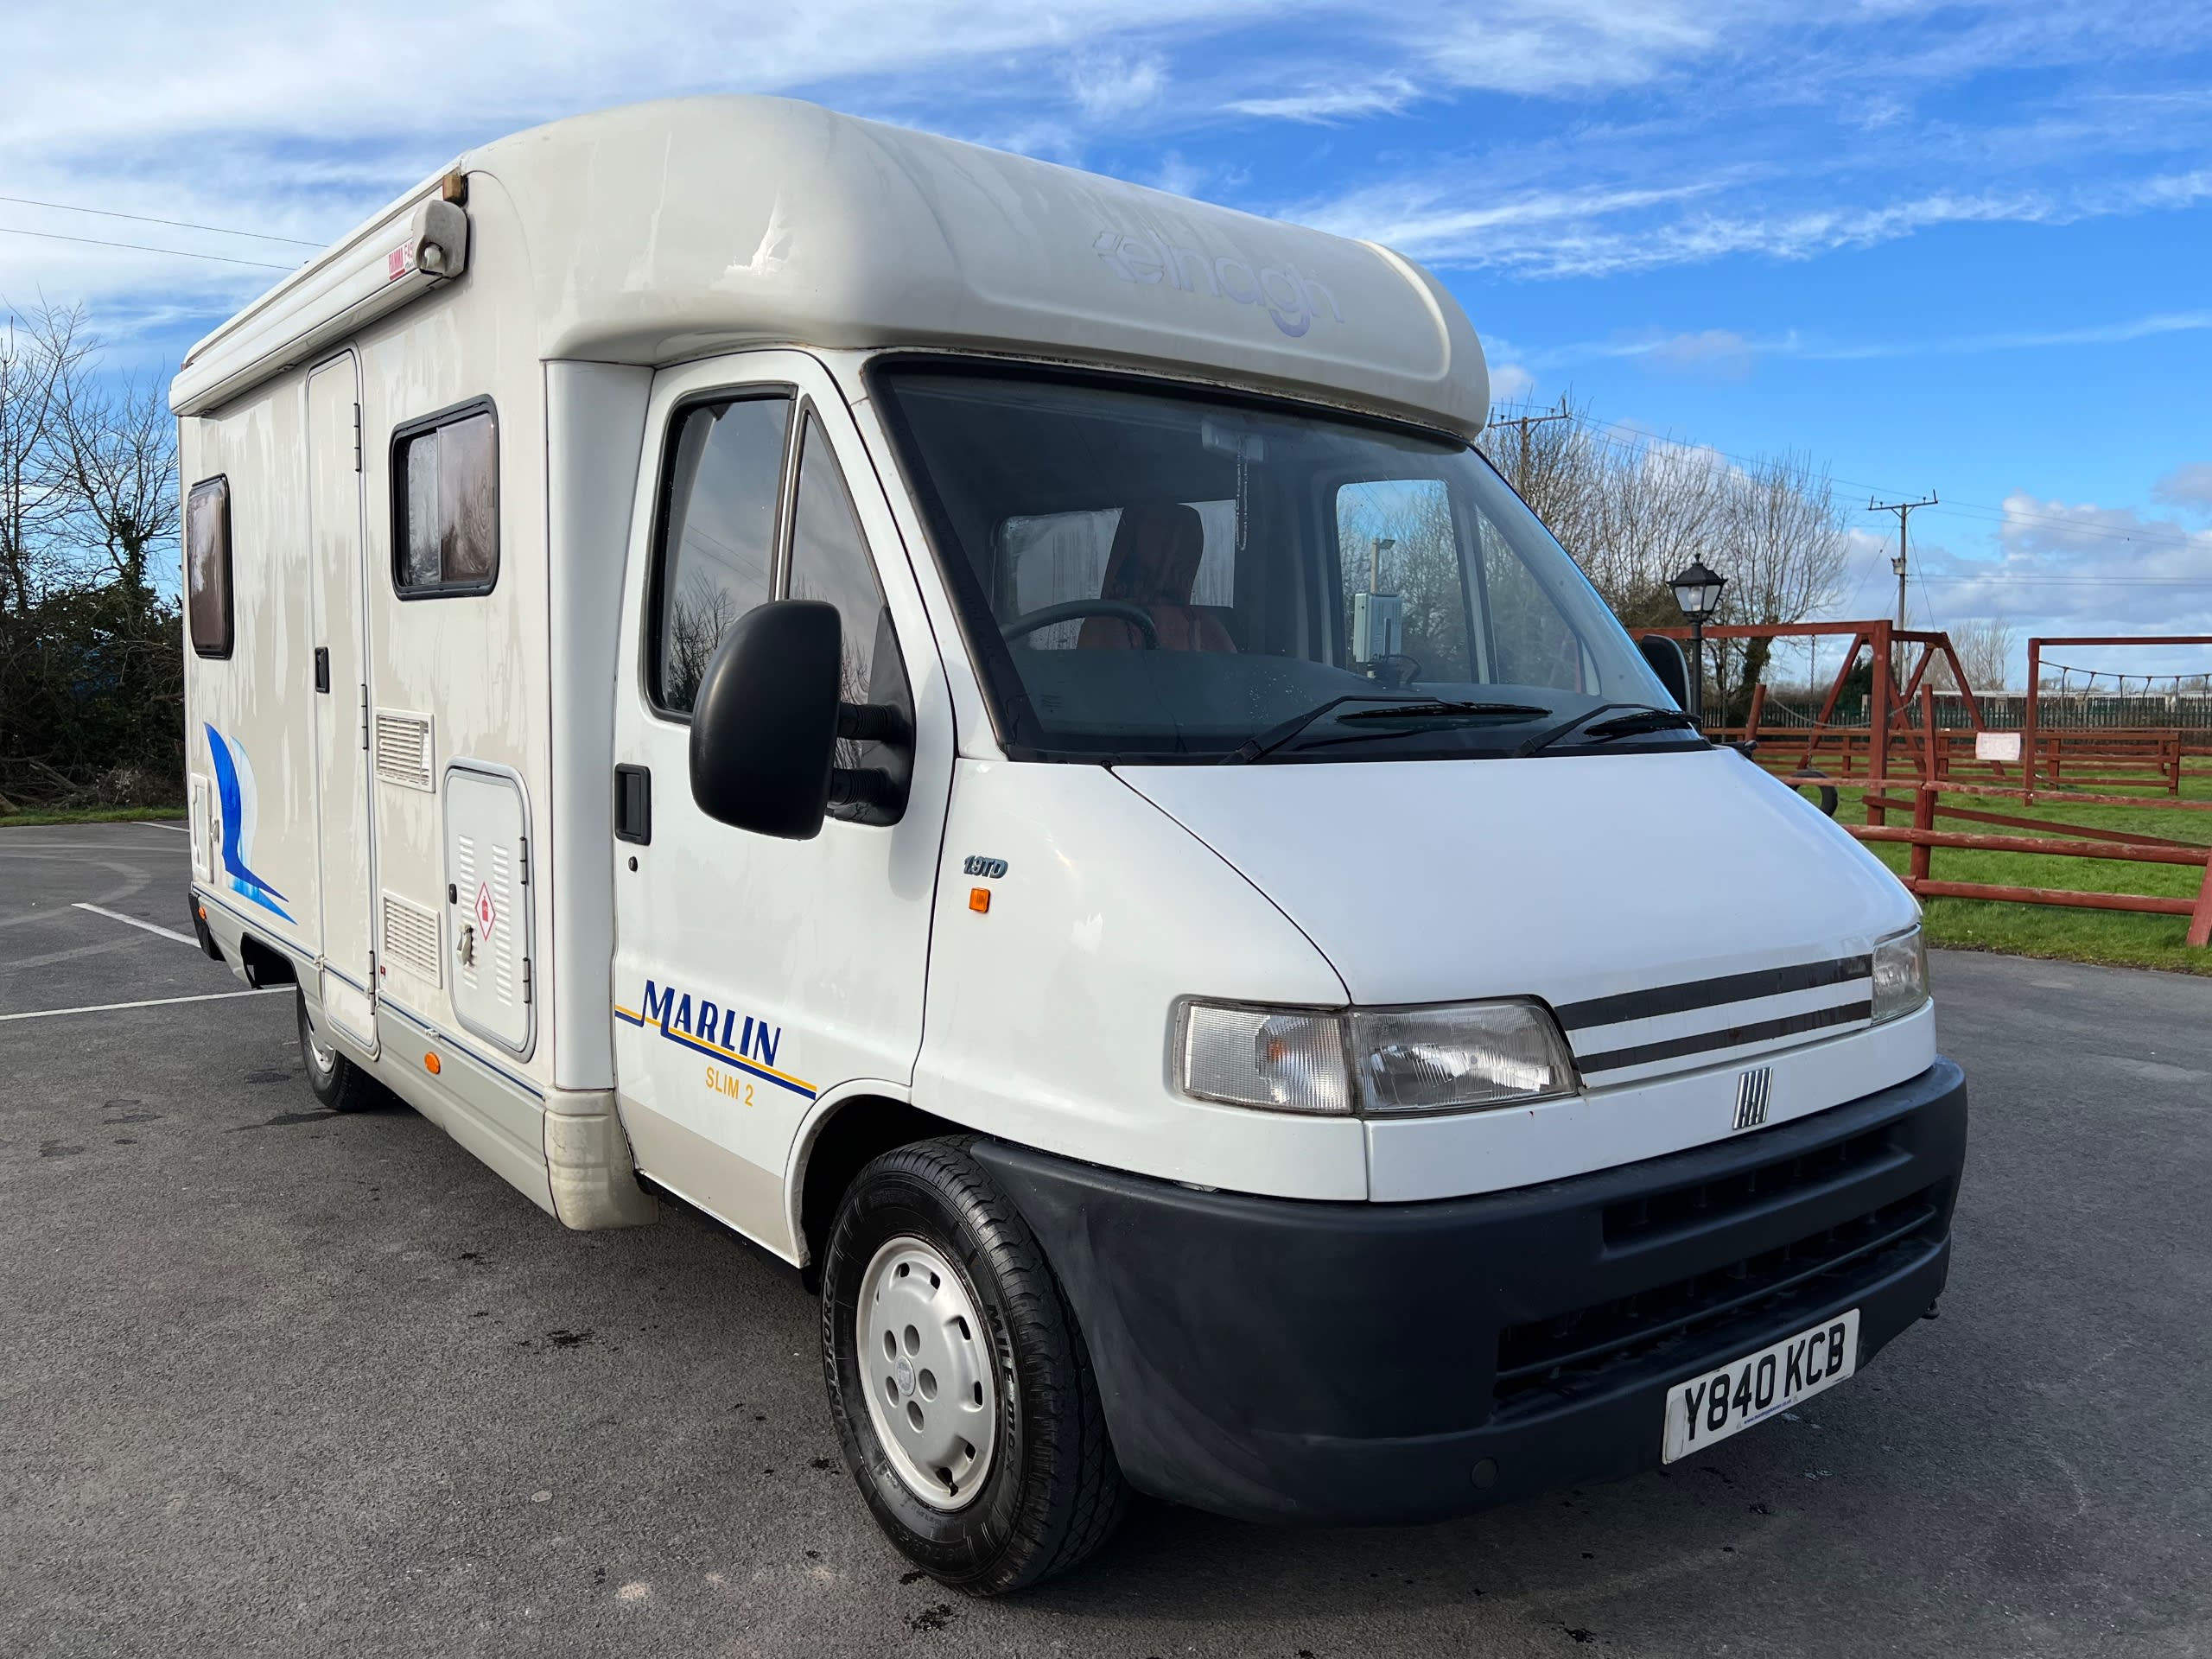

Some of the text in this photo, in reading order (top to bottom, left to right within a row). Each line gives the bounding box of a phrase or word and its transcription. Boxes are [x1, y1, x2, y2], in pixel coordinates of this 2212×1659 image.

[642, 979, 782, 1067] MARLIN
[705, 1066, 754, 1108] SLIM 2
[1684, 1322, 1847, 1442] Y840 KCB
